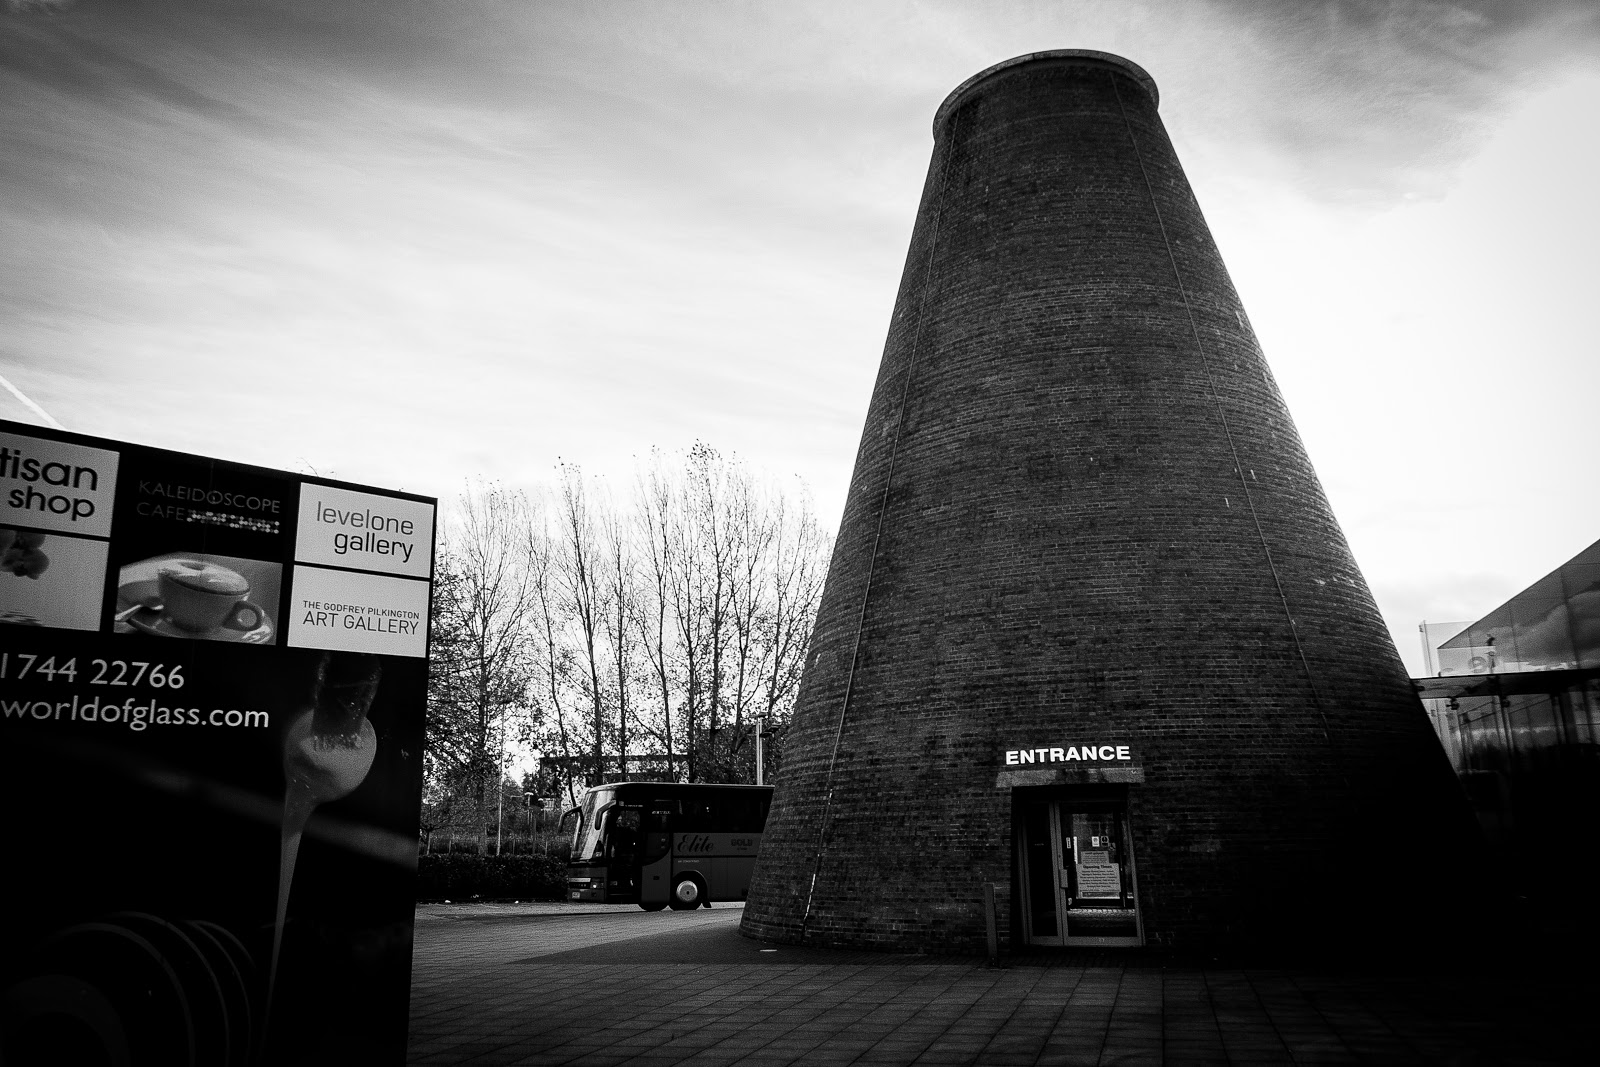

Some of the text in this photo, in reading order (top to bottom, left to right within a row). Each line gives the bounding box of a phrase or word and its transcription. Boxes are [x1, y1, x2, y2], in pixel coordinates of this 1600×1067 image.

[0, 447, 98, 491] tisan
[8, 486, 96, 522] shop
[136, 502, 186, 521] CAFE
[138, 480, 281, 514] KALEIDOSCOPE
[316, 501, 414, 535] levelone
[334, 532, 414, 563] gallery
[302, 610, 419, 635] ART GALLERY
[303, 600, 420, 620] THE GODFREY PILKINGTON
[89, 658, 185, 689] 22766
[0, 695, 270, 731] worldofglass.com
[1005, 745, 1131, 765] ENTRANCE
[677, 834, 714, 853] Elite
